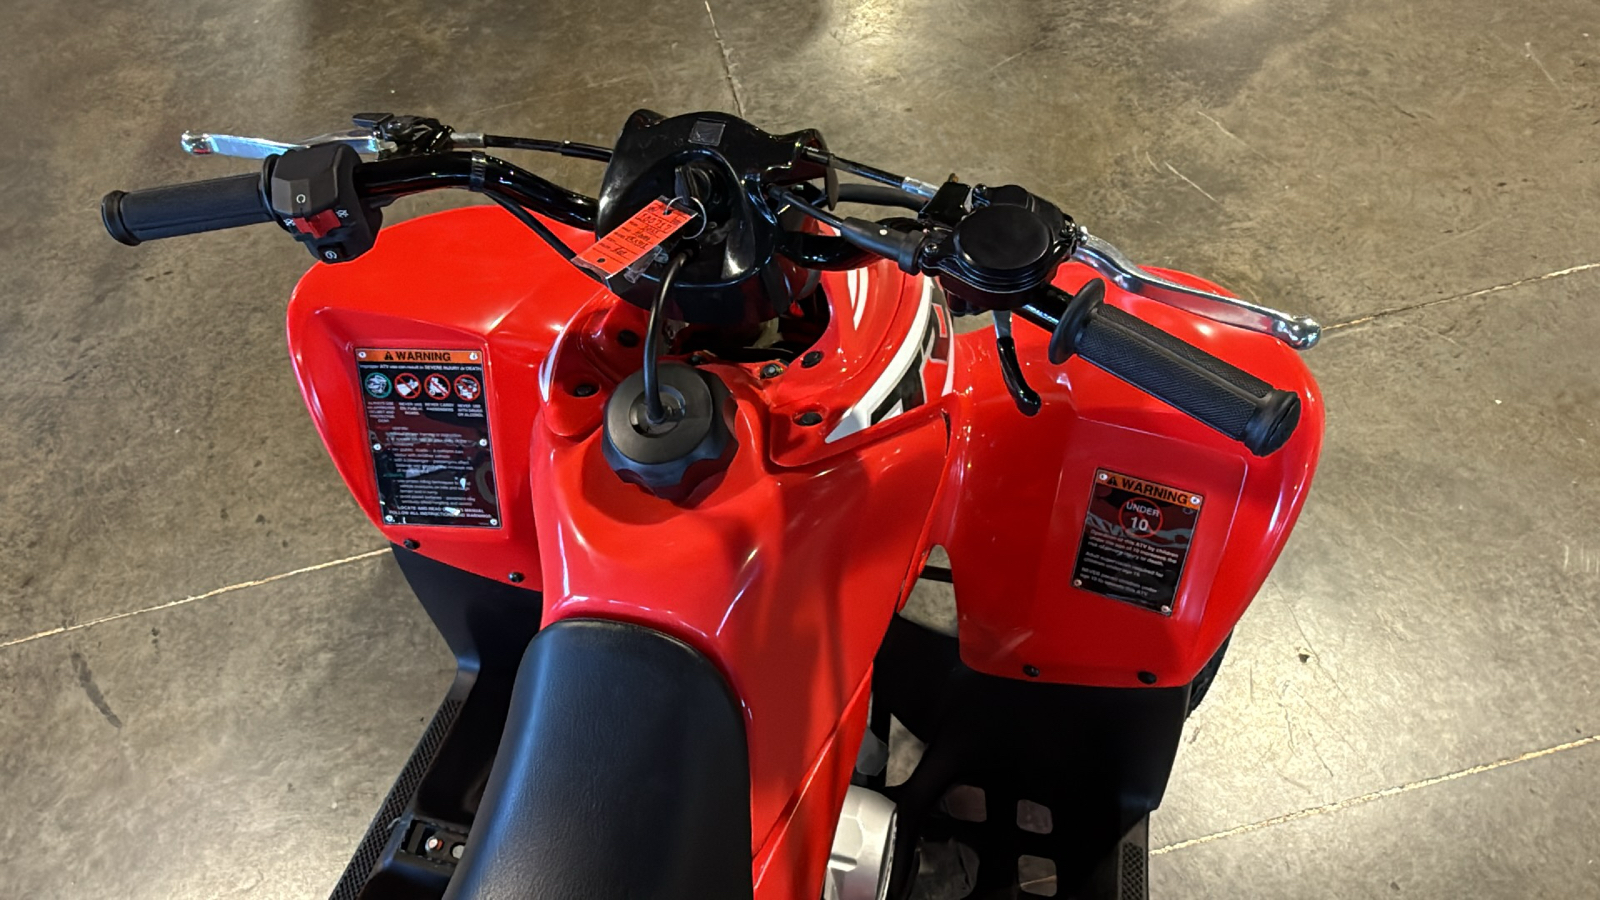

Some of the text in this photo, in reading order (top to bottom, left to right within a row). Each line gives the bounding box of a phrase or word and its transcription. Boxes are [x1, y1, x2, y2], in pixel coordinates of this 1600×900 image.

[395, 351, 451, 361] WARNING
[1122, 478, 1189, 505] WARNING
[1126, 501, 1160, 517] UNDER
[1131, 516, 1148, 531] 10
[1135, 541, 1147, 549] ATV
